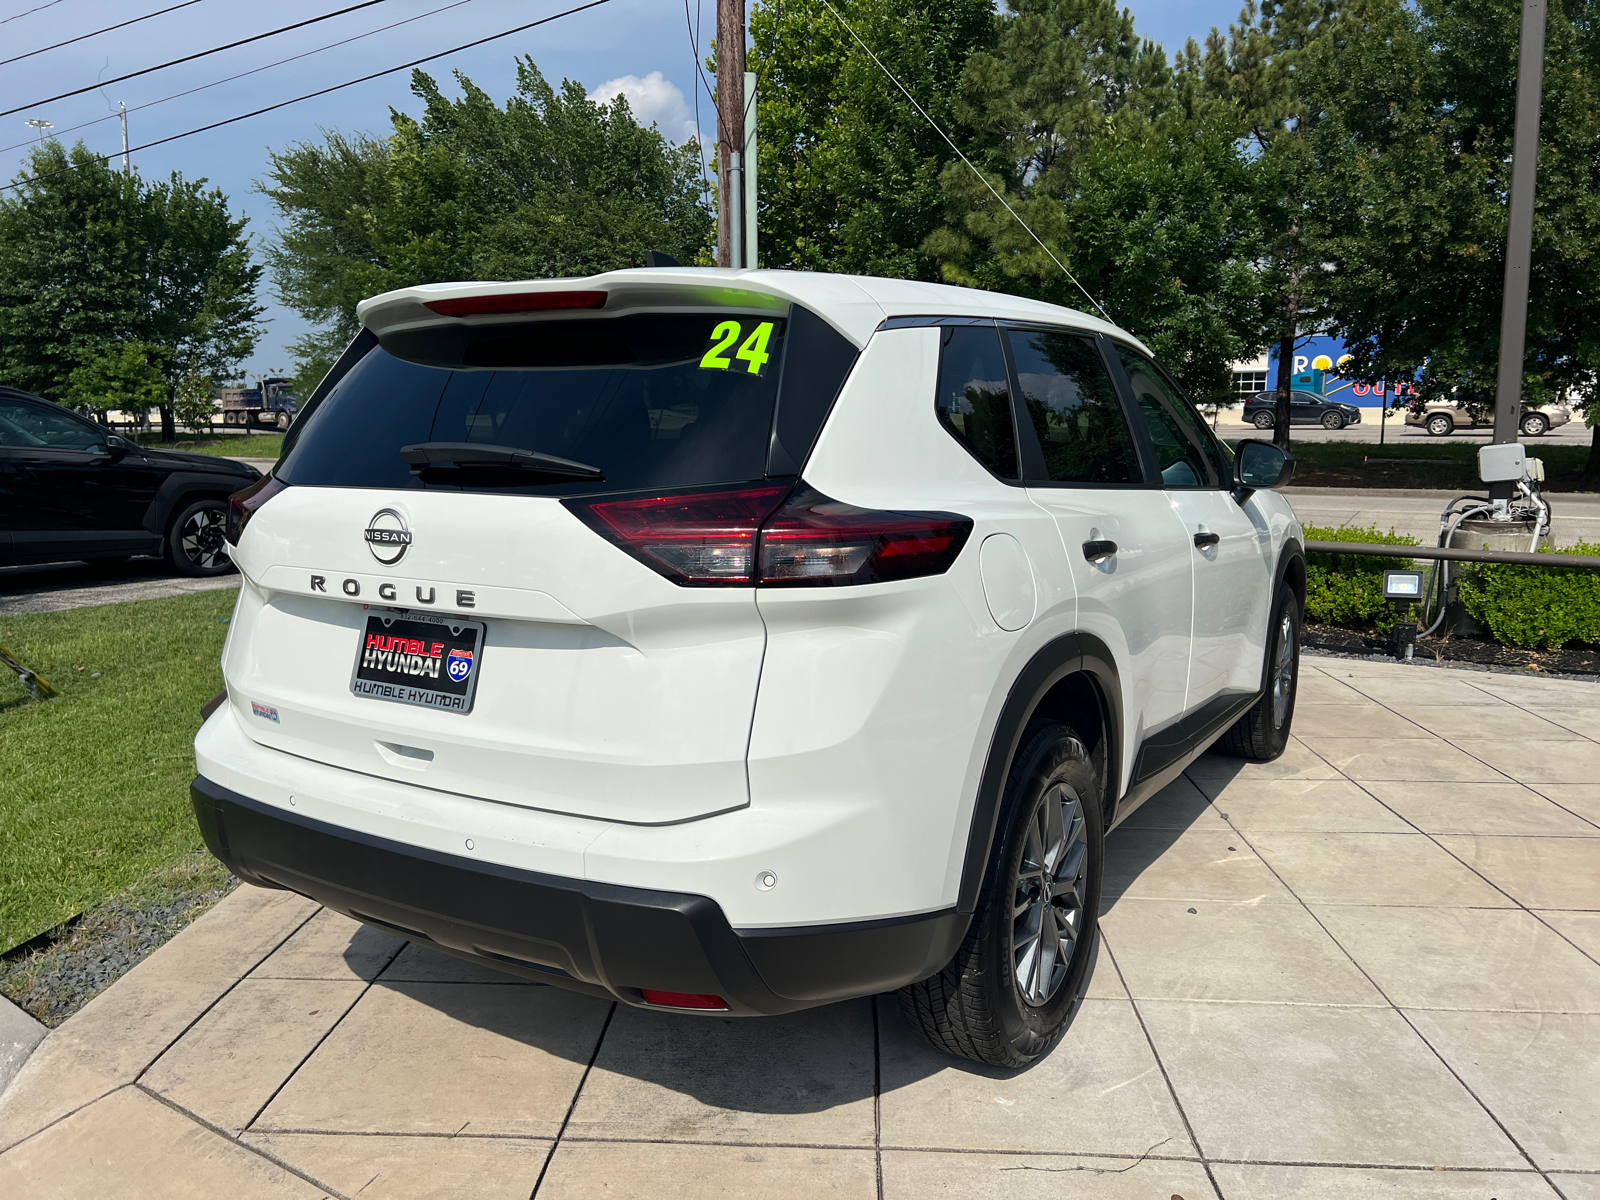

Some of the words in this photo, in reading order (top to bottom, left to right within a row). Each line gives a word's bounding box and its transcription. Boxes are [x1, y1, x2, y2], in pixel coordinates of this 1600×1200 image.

[700, 320, 774, 375] 24
[364, 530, 411, 543] NISSAN
[310, 574, 476, 609] ROGUE
[366, 633, 445, 658] HUMBLE
[362, 649, 442, 679] HYUNDAI
[449, 660, 469, 676] 69
[354, 681, 404, 699] HUMBLE
[407, 689, 466, 710] HYUNDAI
[1002, 937, 1010, 988] EDGE
